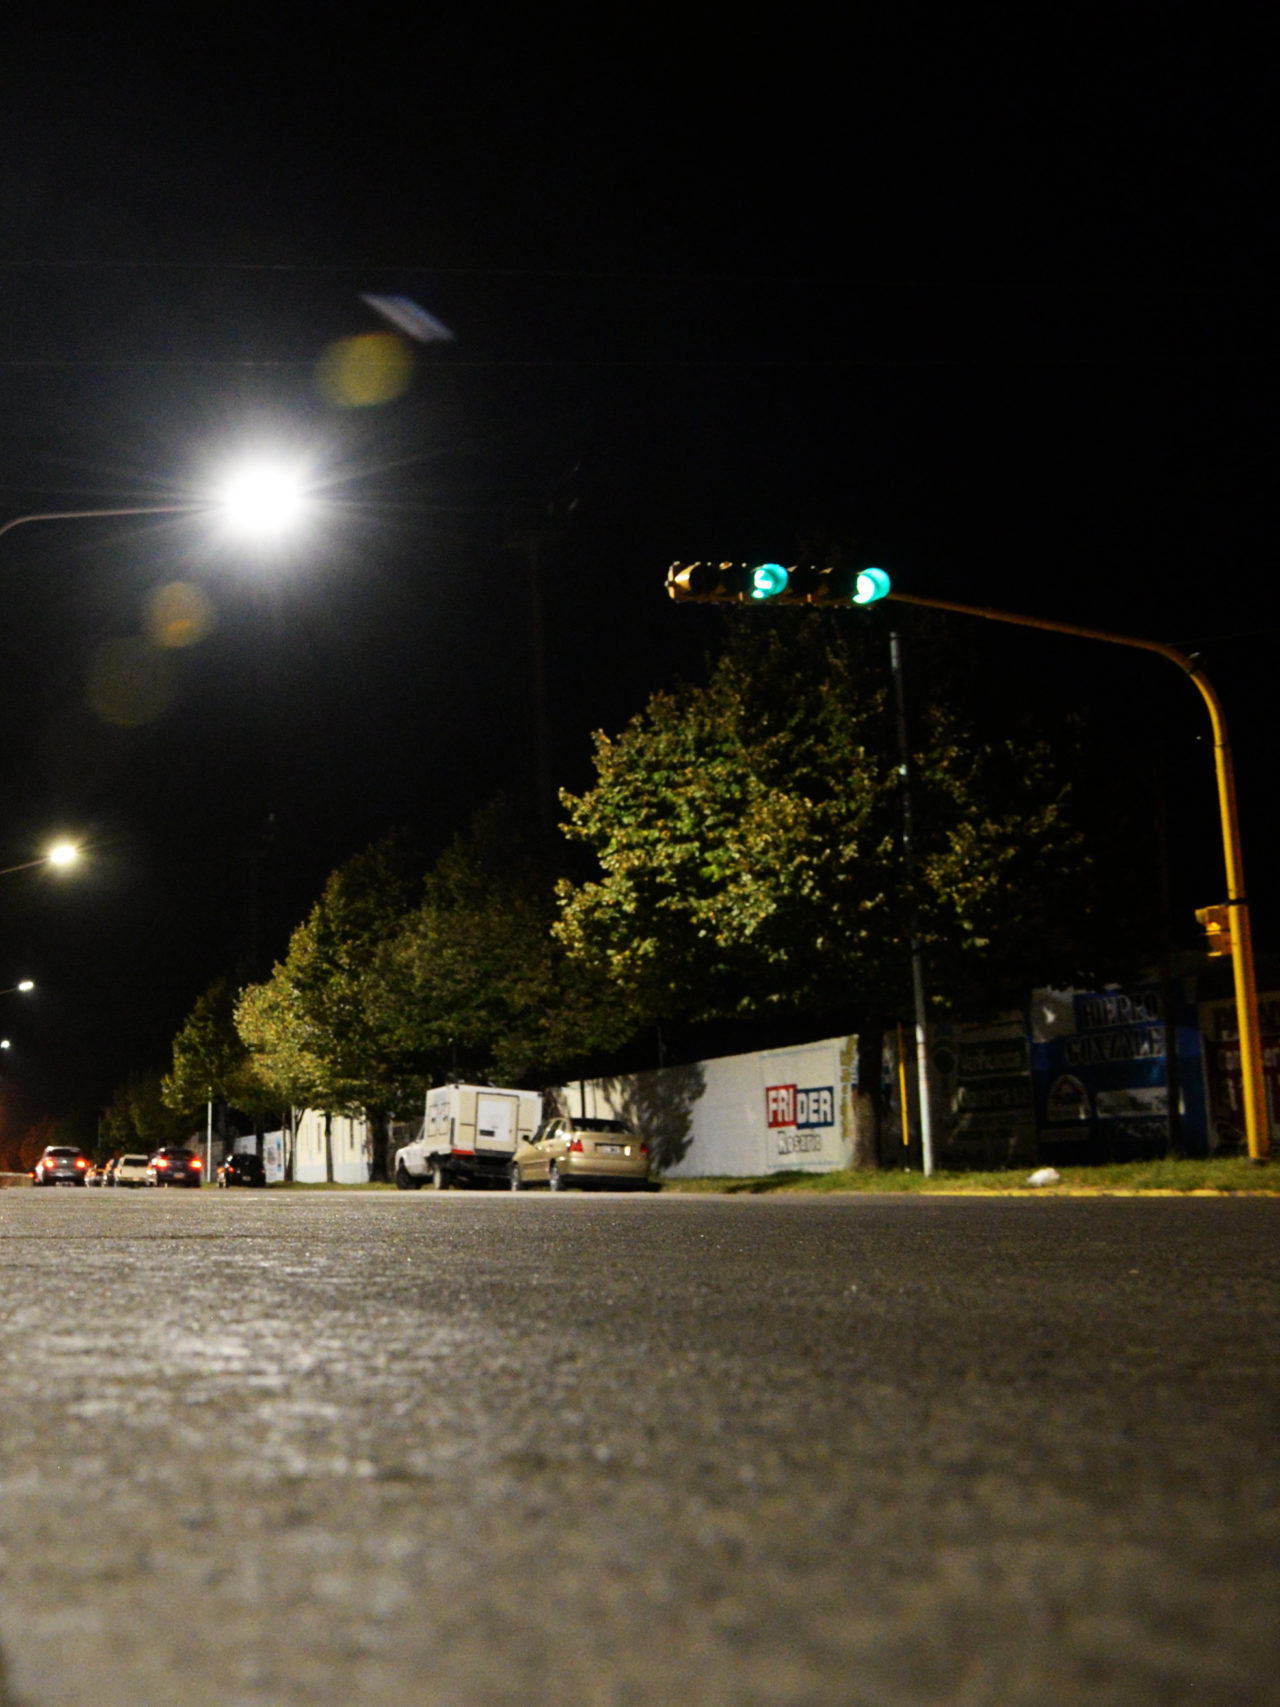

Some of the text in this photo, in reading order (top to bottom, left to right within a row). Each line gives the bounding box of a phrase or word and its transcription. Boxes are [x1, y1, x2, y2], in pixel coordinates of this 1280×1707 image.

[1079, 990, 1161, 1030] HIERRO
[1064, 1025, 1167, 1067] GONZALE
[767, 1087, 832, 1124] FRIDER
